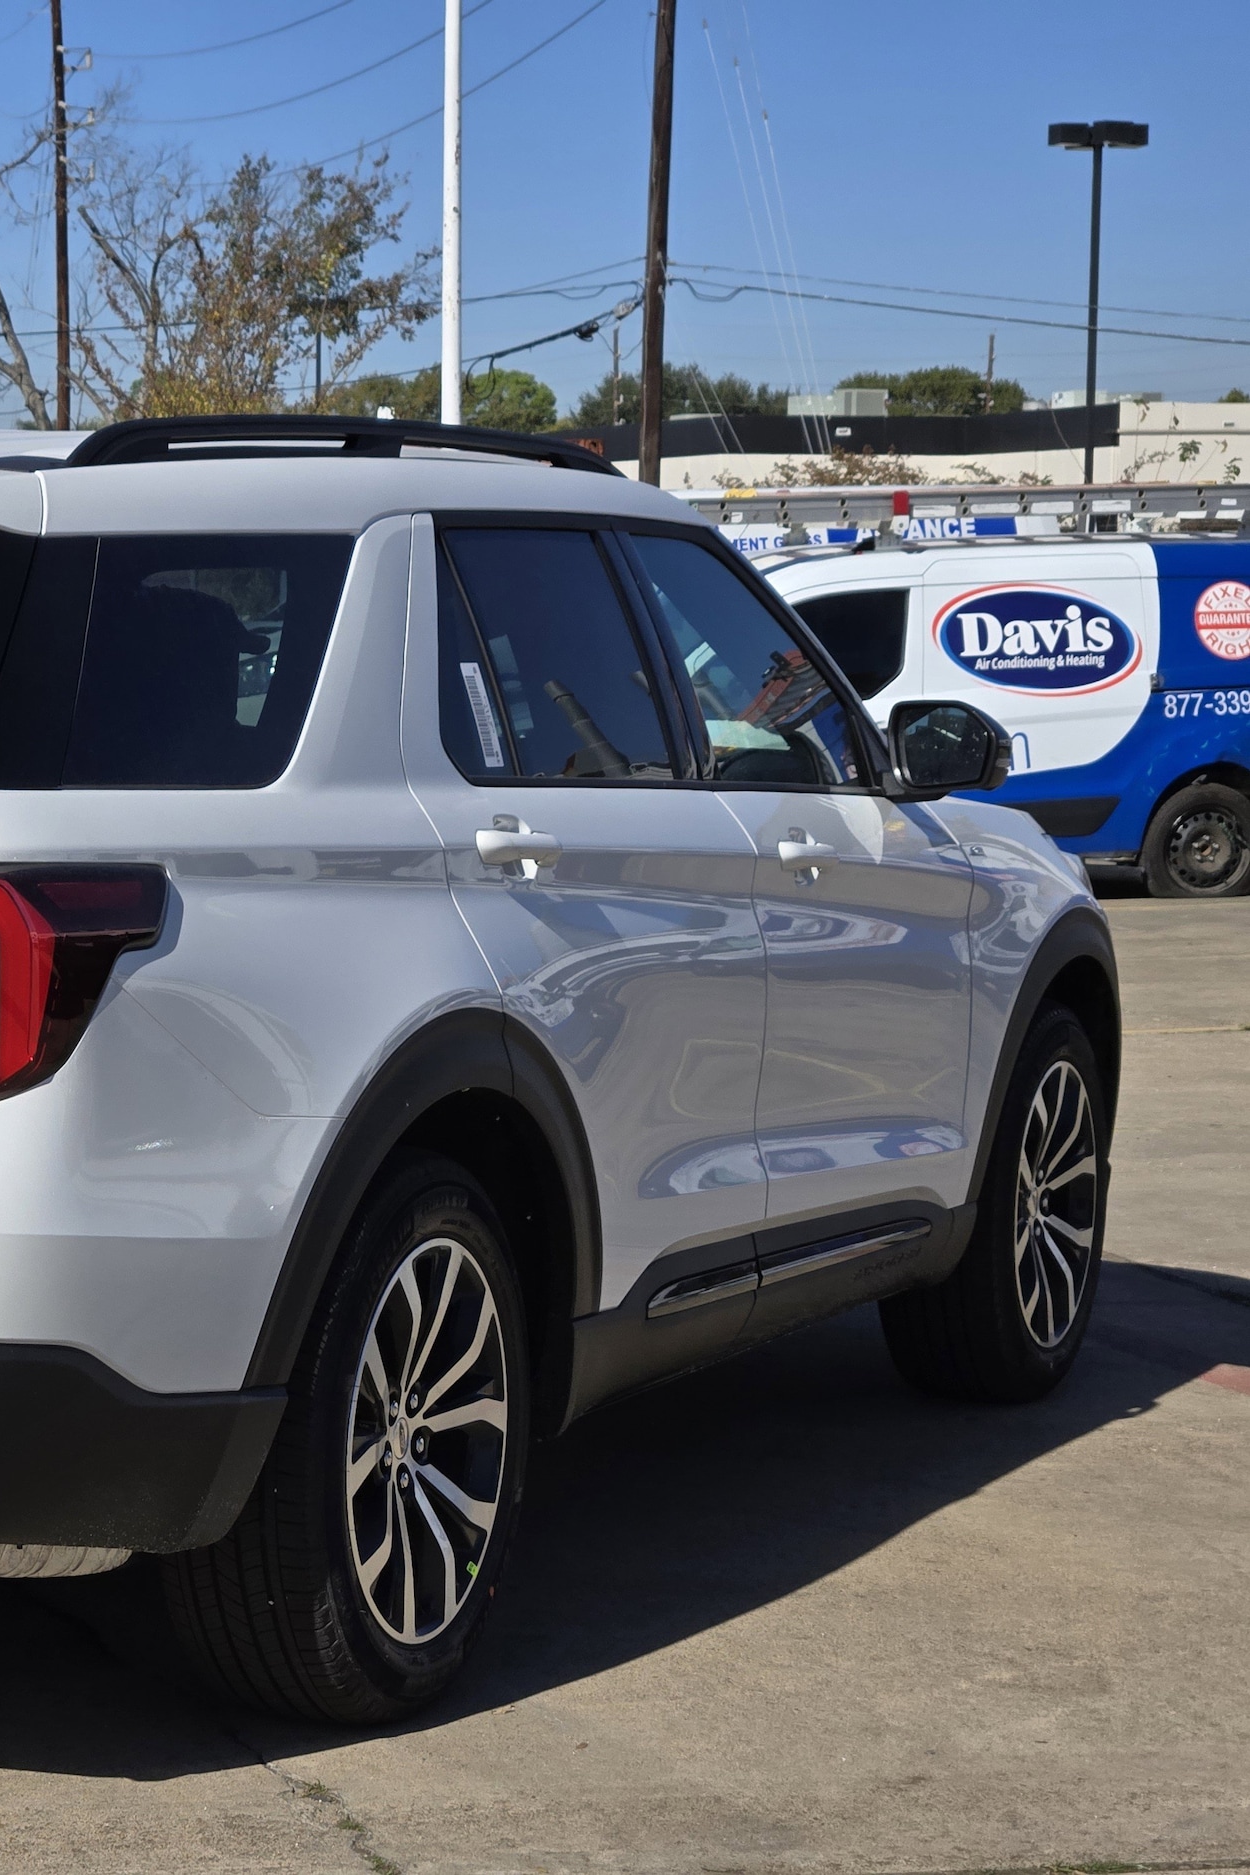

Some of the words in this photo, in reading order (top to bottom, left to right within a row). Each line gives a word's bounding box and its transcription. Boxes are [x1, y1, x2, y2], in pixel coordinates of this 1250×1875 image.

[855, 516, 977, 543] AANCE
[956, 604, 1114, 657] Davis
[975, 658, 990, 671] Air
[992, 655, 1056, 671] Conditioning
[1056, 655, 1065, 667] &
[1065, 654, 1105, 669] Heating
[1164, 690, 1250, 719] 877-339
